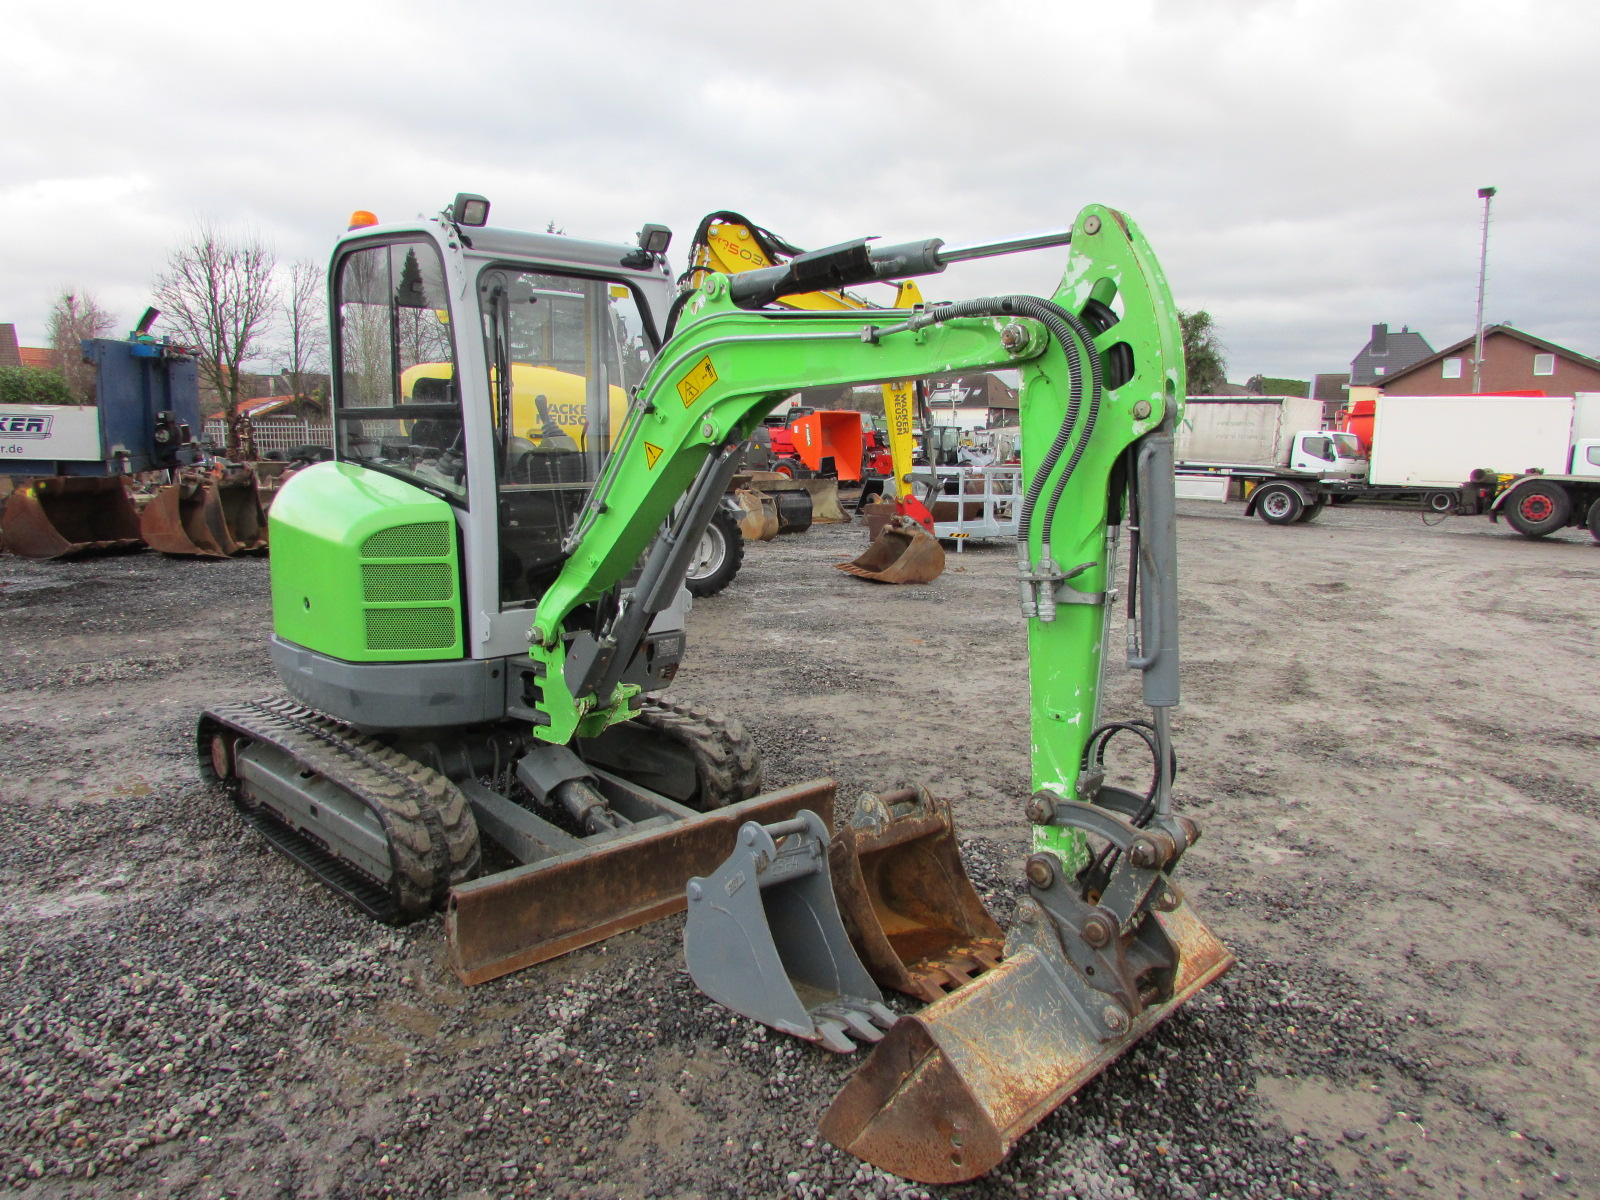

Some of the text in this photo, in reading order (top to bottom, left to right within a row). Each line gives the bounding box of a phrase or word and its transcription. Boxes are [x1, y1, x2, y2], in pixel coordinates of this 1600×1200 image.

[547, 403, 587, 415] ACKE
[894, 394, 903, 435] NEUSON
[901, 393, 909, 434] WACKER
